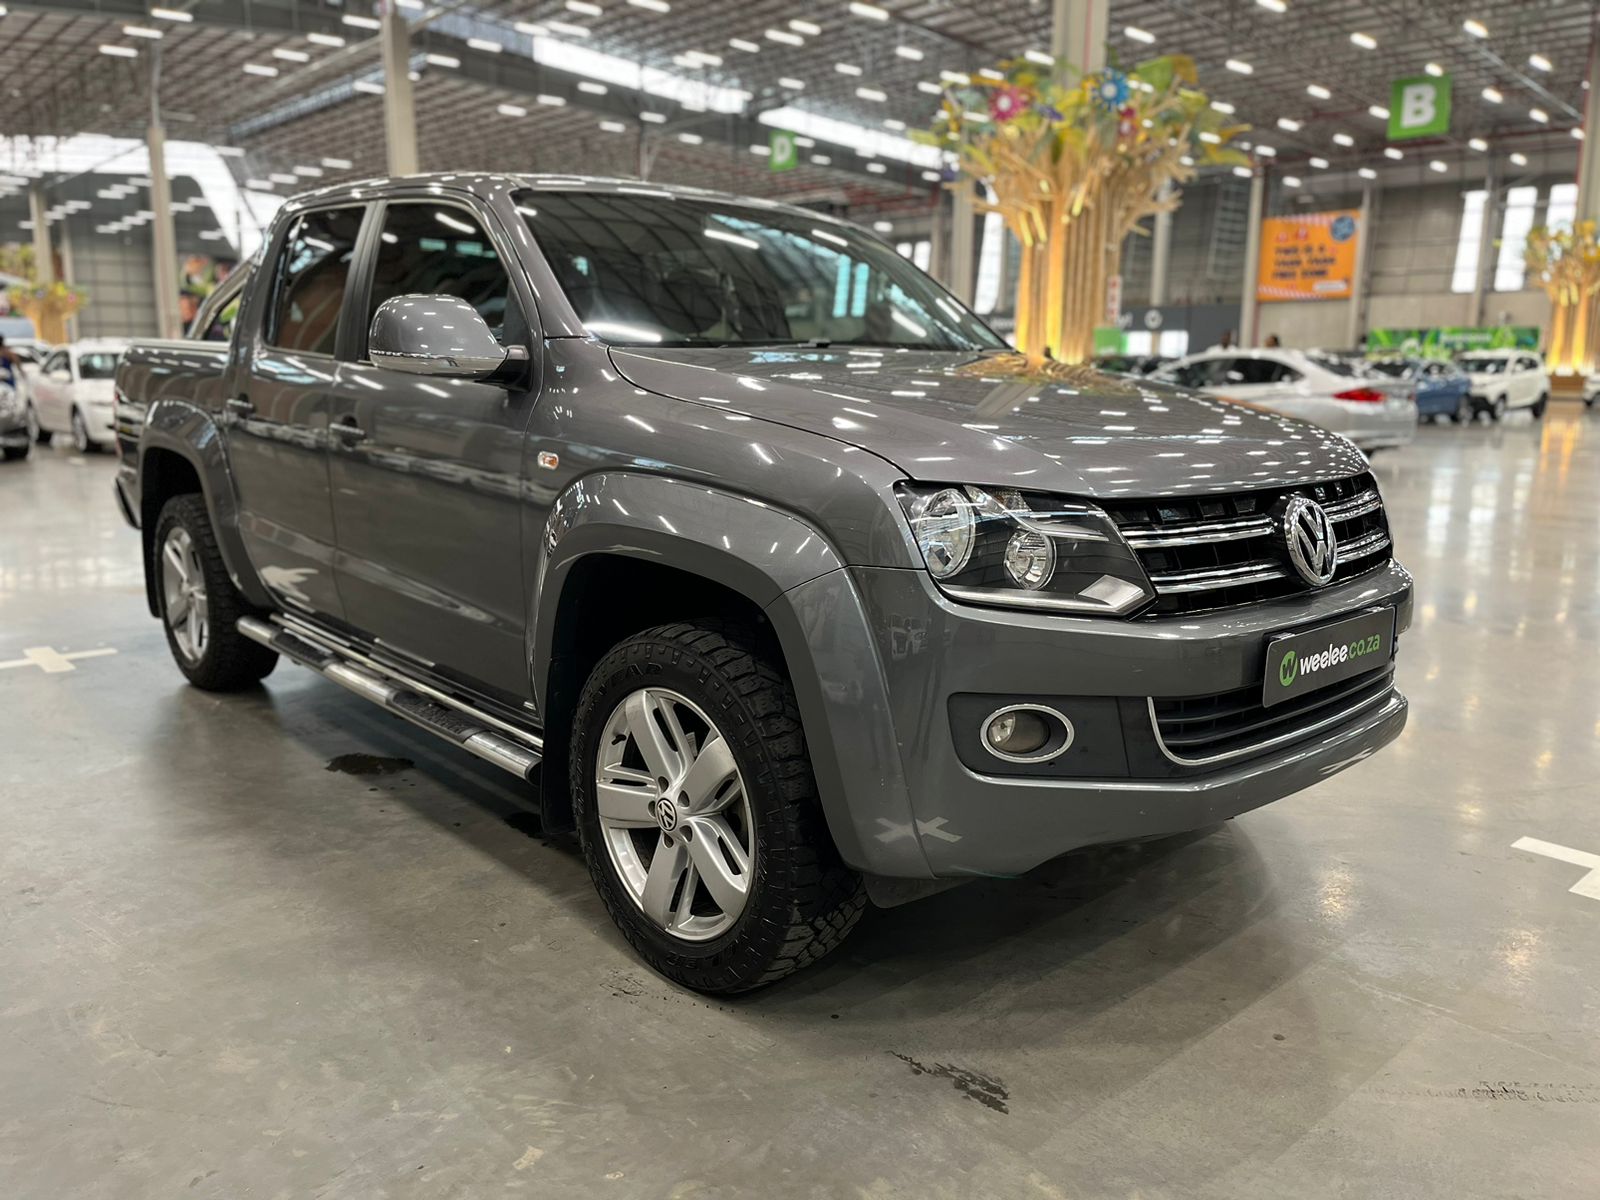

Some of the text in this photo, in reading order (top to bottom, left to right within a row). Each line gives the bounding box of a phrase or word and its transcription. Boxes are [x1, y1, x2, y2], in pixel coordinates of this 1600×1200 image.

[1401, 84, 1437, 128] B
[773, 135, 792, 163] D
[1300, 634, 1381, 676] weelee.co.za
